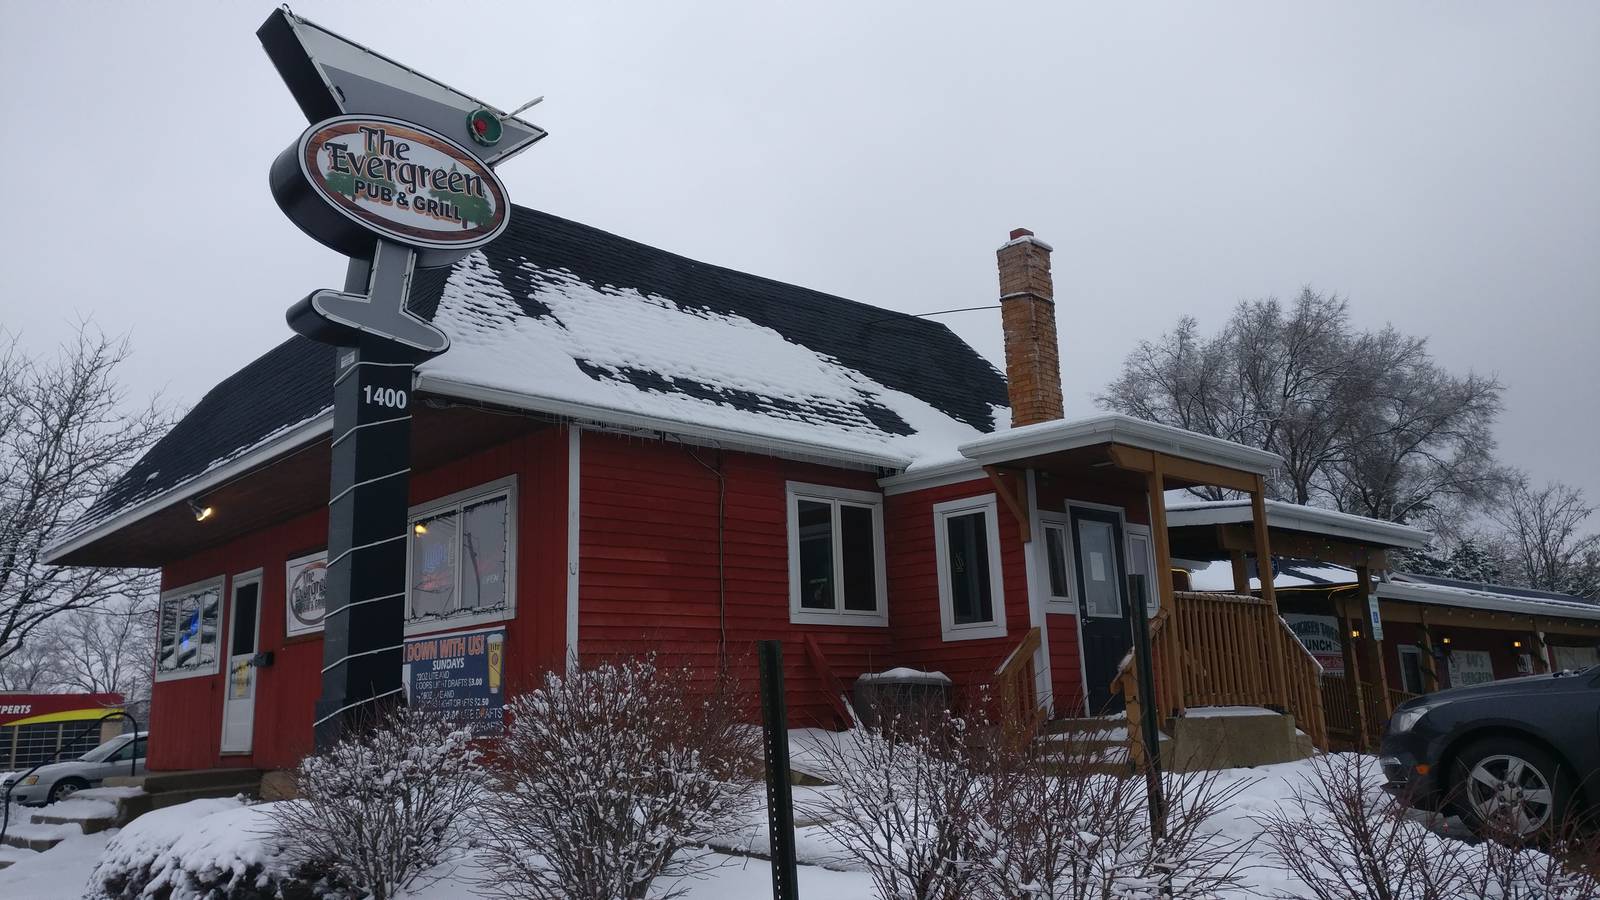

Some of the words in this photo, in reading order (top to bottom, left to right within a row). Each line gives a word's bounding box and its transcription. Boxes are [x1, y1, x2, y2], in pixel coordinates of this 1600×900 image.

[359, 126, 410, 161] The
[324, 141, 485, 197] Evergreen
[354, 179, 392, 202] PUB
[396, 191, 409, 207] &
[414, 195, 462, 221] GRILL
[363, 385, 407, 409] 1400
[407, 641, 437, 661] DOWN
[440, 637, 466, 658] WITH
[1303, 639, 1332, 651] UNCH
[432, 658, 465, 670] SUNDAYS
[448, 678, 468, 688] DRAFTS
[468, 677, 483, 687] $3.00
